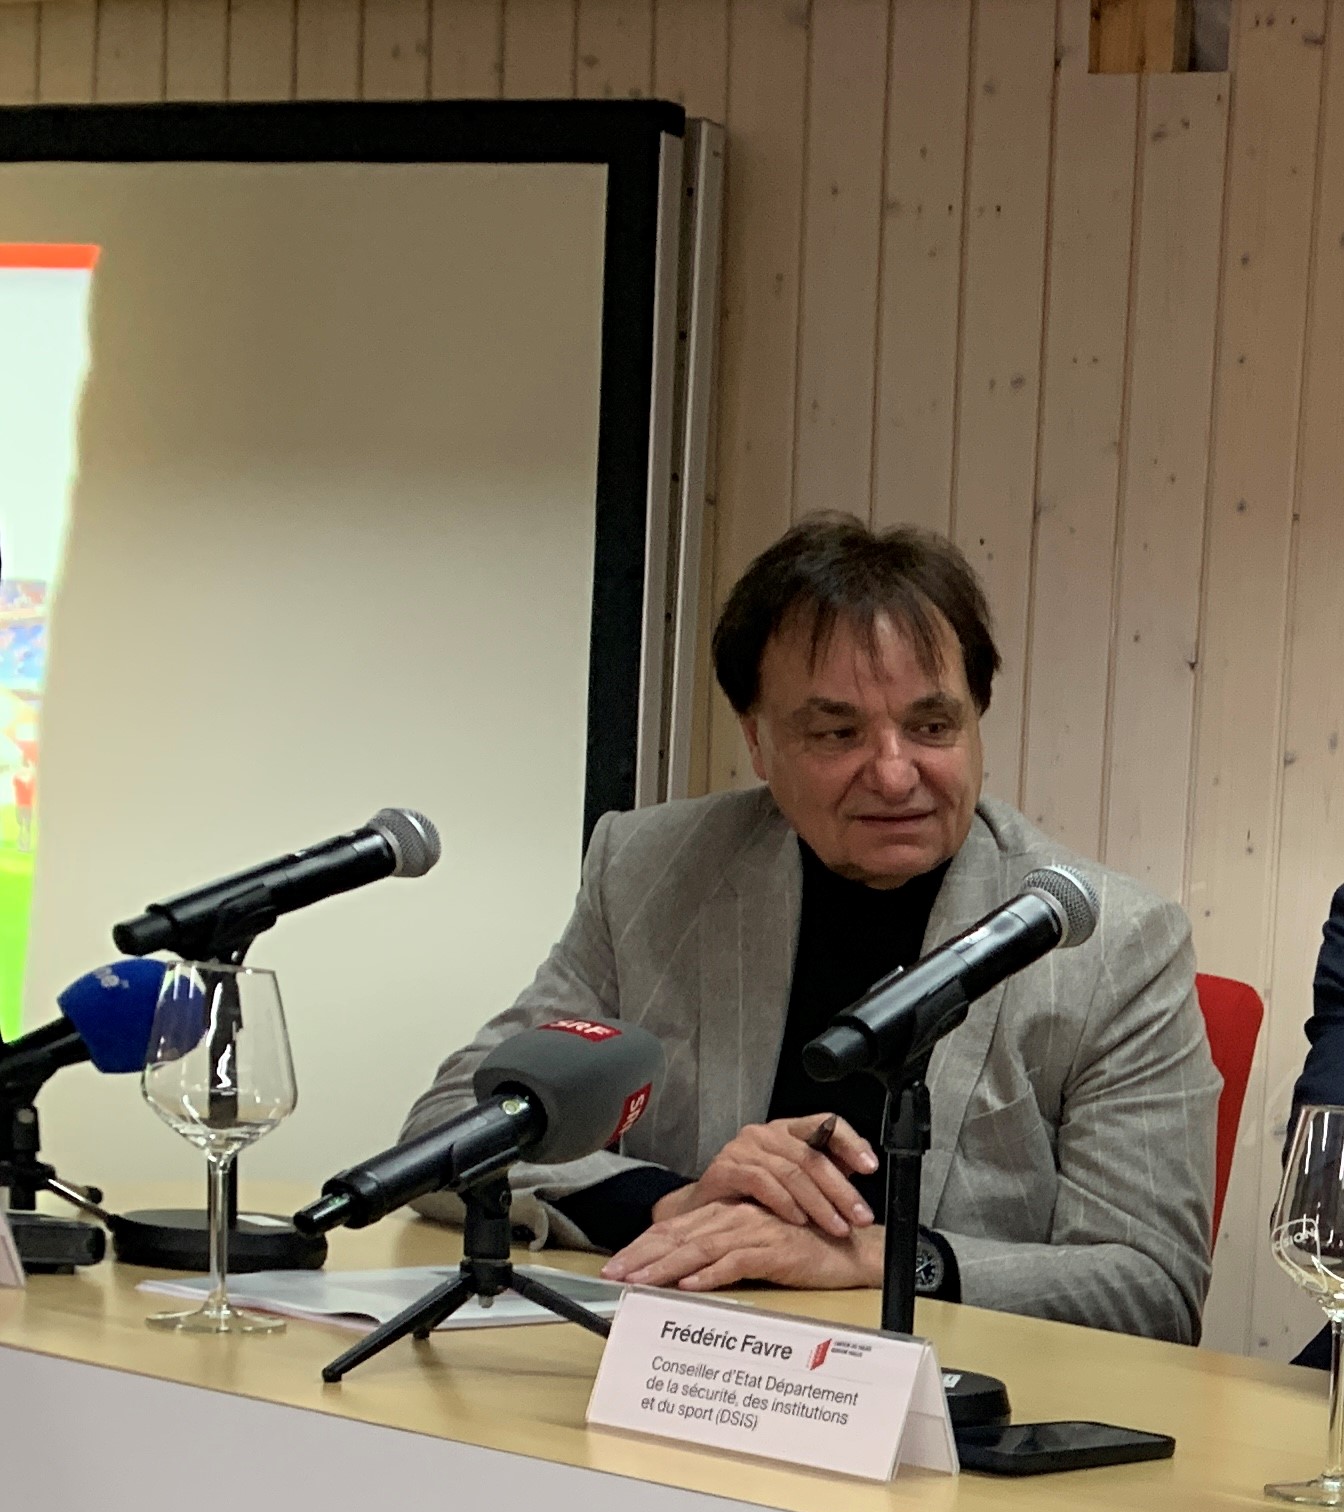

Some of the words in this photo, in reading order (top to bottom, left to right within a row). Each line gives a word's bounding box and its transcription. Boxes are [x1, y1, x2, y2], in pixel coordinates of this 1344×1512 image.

[550, 1019, 613, 1035] SRF
[660, 1320, 738, 1351] Frédéric
[740, 1334, 793, 1360] Favre
[646, 1375, 665, 1392] de
[667, 1378, 679, 1394] la
[681, 1382, 739, 1407] sécurité,
[742, 1393, 768, 1411] des
[771, 1397, 849, 1426] institutions
[651, 1355, 720, 1381] Conseiller
[722, 1369, 763, 1389] d'Etat
[765, 1375, 859, 1406] Département
[640, 1395, 656, 1410] et
[657, 1399, 675, 1414] du
[677, 1402, 714, 1421] sport
[715, 1408, 759, 1431] (DSIS)
